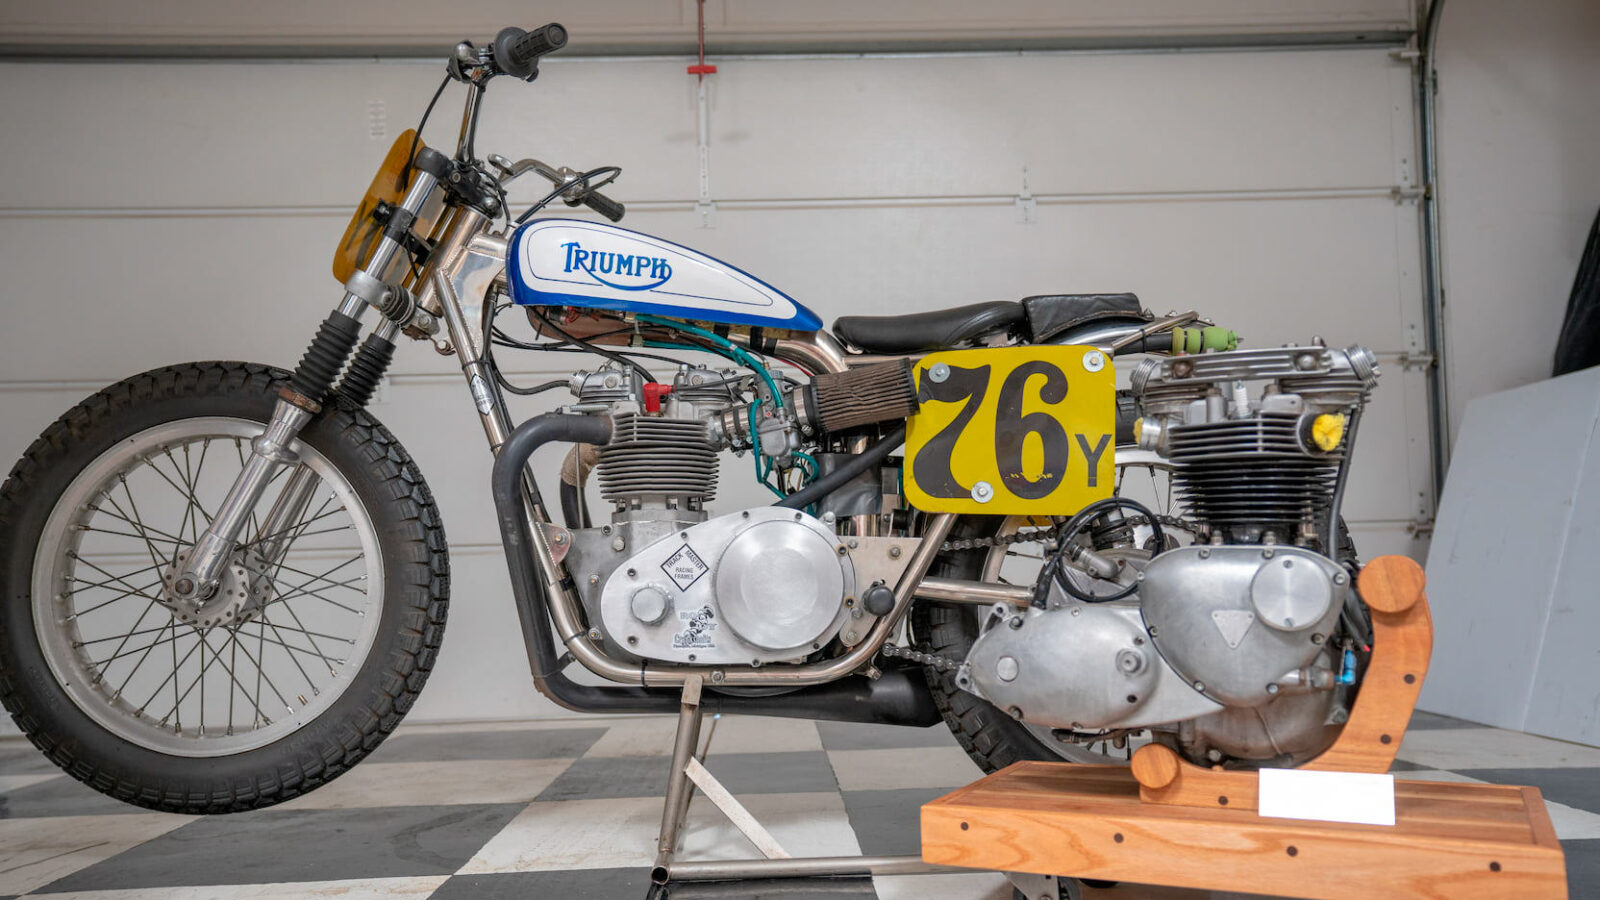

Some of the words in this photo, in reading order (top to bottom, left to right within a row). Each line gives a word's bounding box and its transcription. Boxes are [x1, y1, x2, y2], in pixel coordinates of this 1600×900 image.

[560, 242, 672, 291] TRIUMPH
[666, 553, 683, 568] TRACK
[685, 550, 704, 570] MASTER
